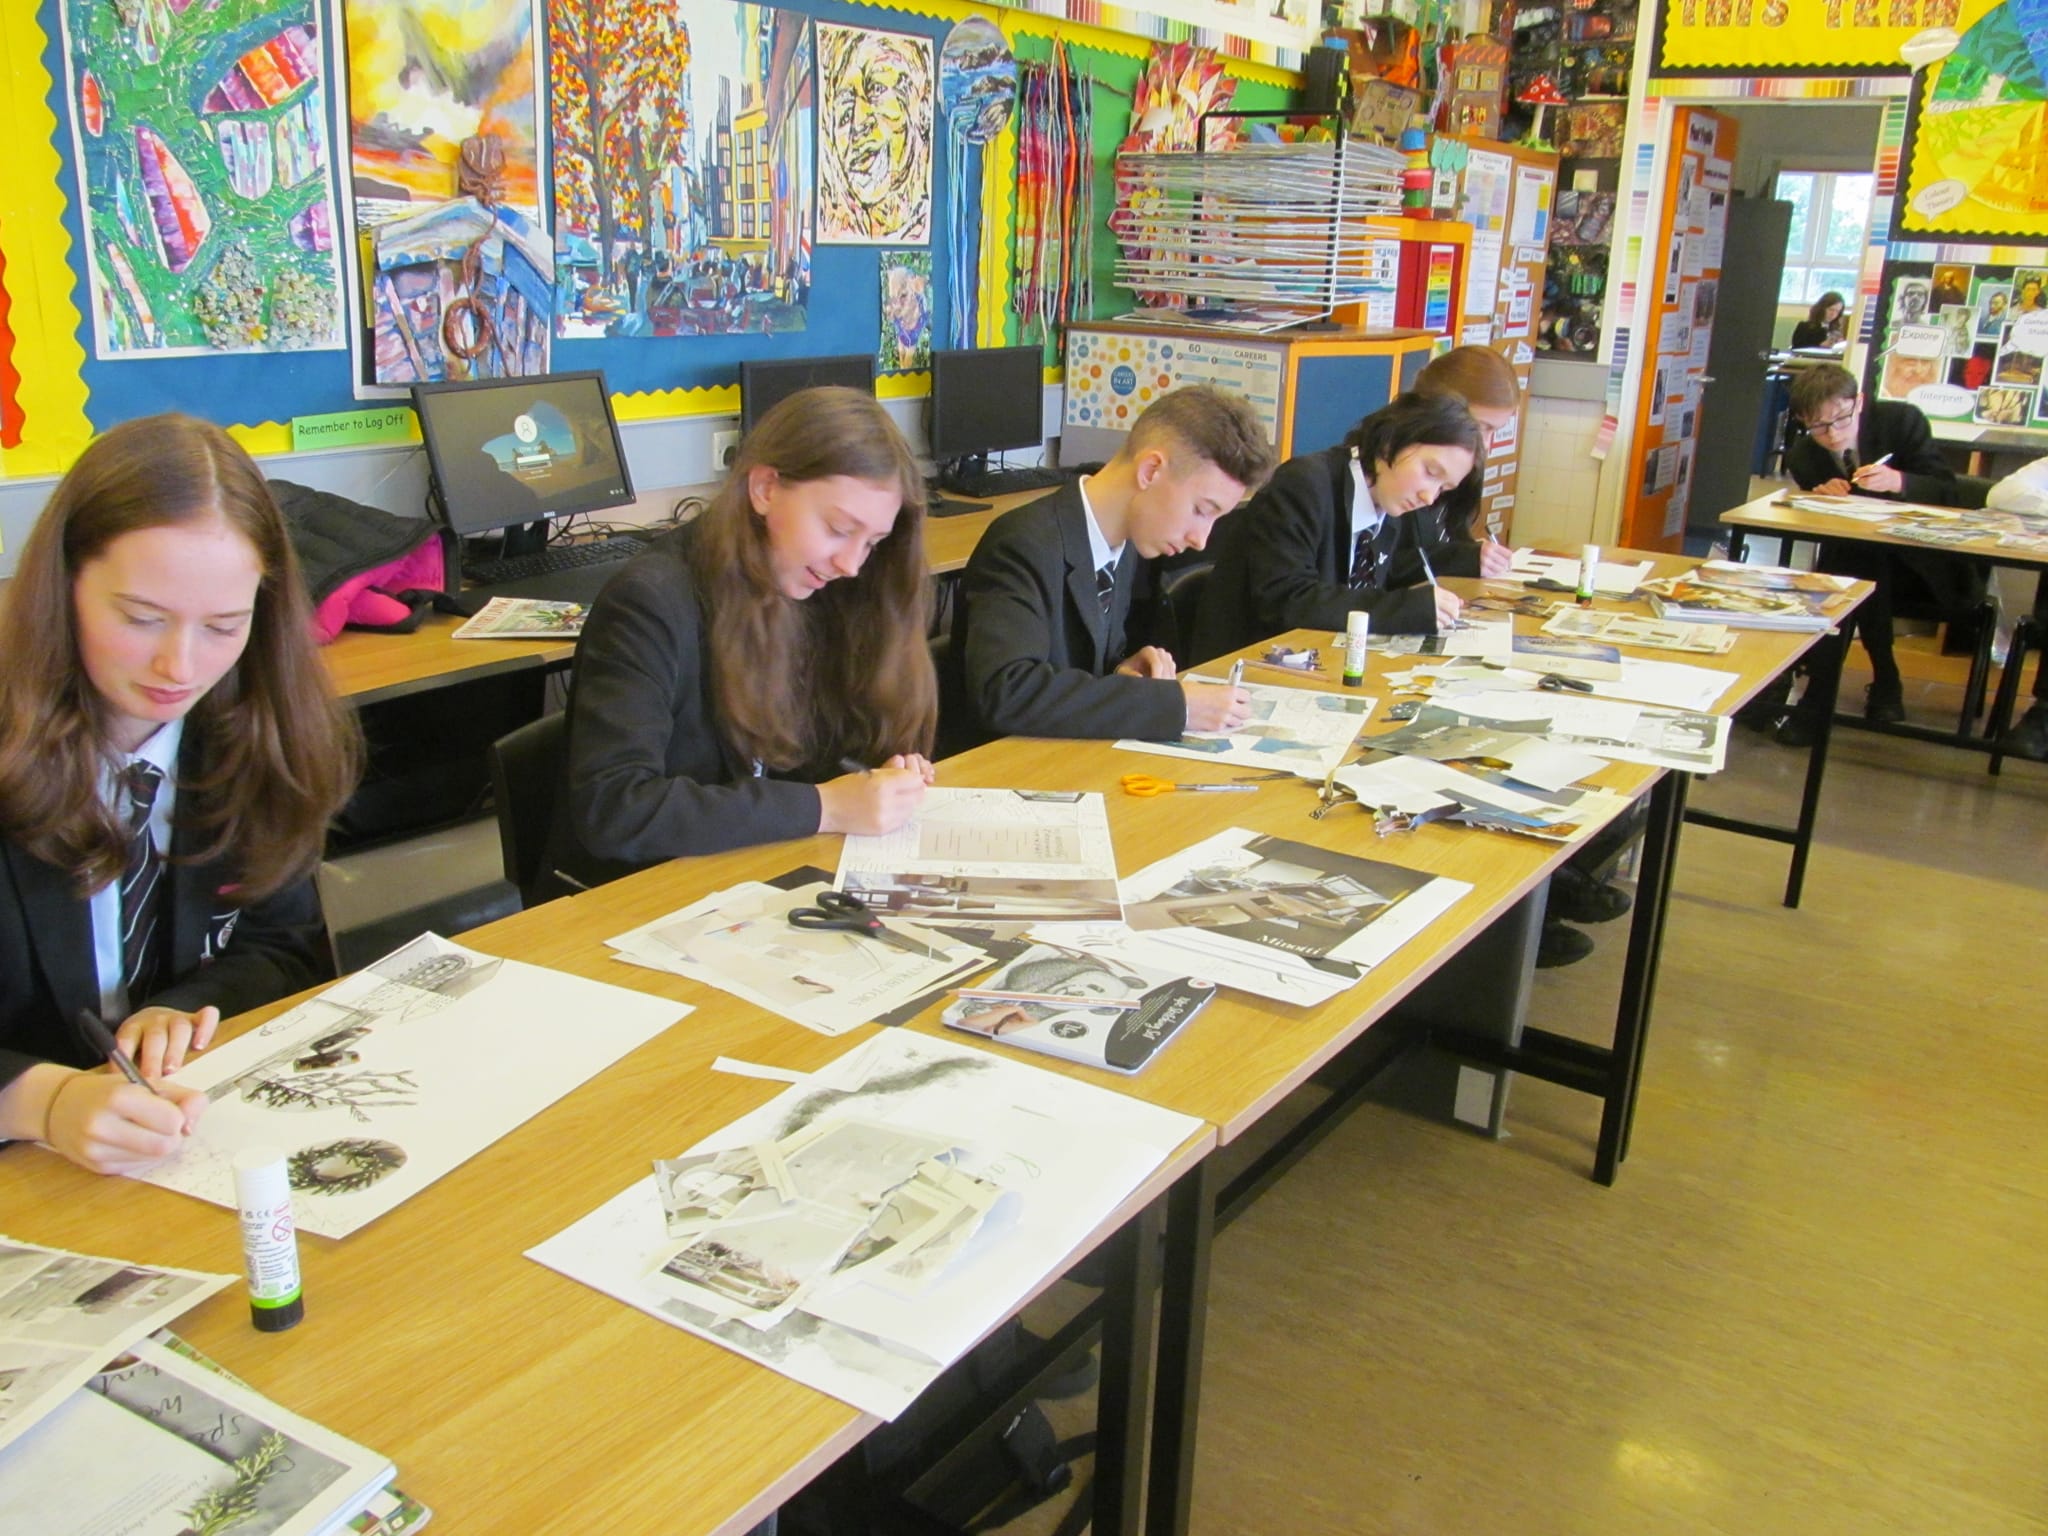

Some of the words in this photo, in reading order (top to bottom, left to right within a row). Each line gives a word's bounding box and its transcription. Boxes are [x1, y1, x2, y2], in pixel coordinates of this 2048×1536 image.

[1679, 0, 1789, 28] THIS
[1823, 0, 1959, 28] TERM
[1902, 330, 1940, 341] Explore
[1234, 350, 1267, 361] CAREERS
[298, 420, 351, 435] Remember
[353, 420, 363, 429] to
[365, 417, 383, 430] Log
[385, 414, 404, 426] Off
